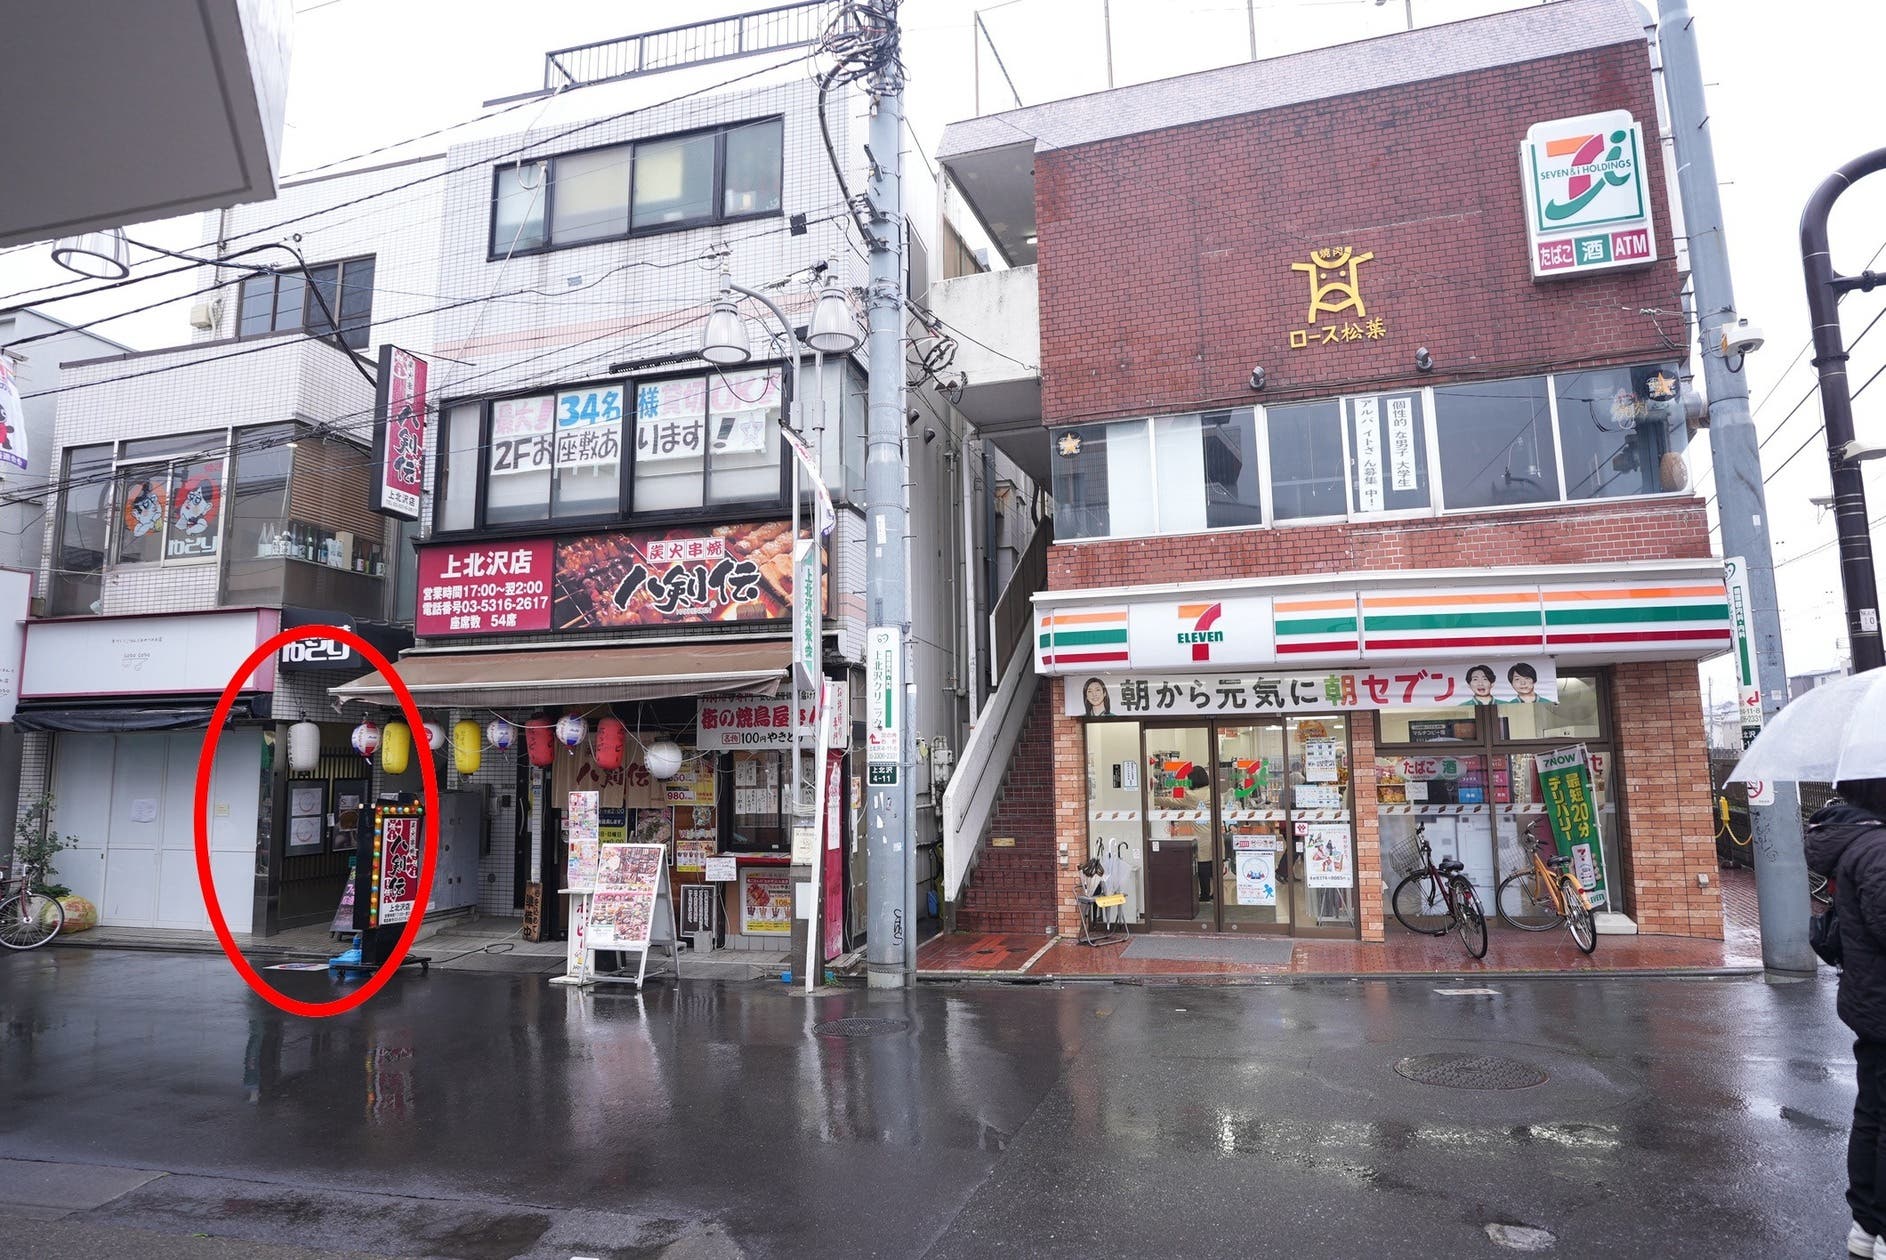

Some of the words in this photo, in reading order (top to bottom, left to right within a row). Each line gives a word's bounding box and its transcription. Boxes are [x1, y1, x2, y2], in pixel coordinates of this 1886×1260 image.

[1582, 159, 1632, 174] HOLDINGS
[1540, 244, 1574, 266] たばこ
[1581, 239, 1604, 262] 酒
[1615, 233, 1648, 257] ATM
[1289, 316, 1387, 348] ロース松葉
[1392, 401, 1412, 488] 個性的な男子大学生
[649, 541, 723, 560] 炭火串焼
[440, 548, 533, 579] 上北沢店
[613, 556, 762, 614] 八剣伝
[422, 595, 549, 617] 電話番号03-5316-2617
[449, 615, 481, 630] 座席数
[490, 612, 518, 628] 54席
[1119, 669, 1455, 712] 朝から元気に朝セブン
[871, 766, 893, 774] 上北沢
[1403, 760, 1437, 775] たばこ
[1442, 760, 1457, 774] 酒
[1543, 753, 1576, 768] 7NOW
[872, 774, 891, 783] 4-11
[667, 791, 685, 801] 980
[1565, 772, 1591, 838] 最短20分
[1548, 775, 1572, 841] デリバリー
